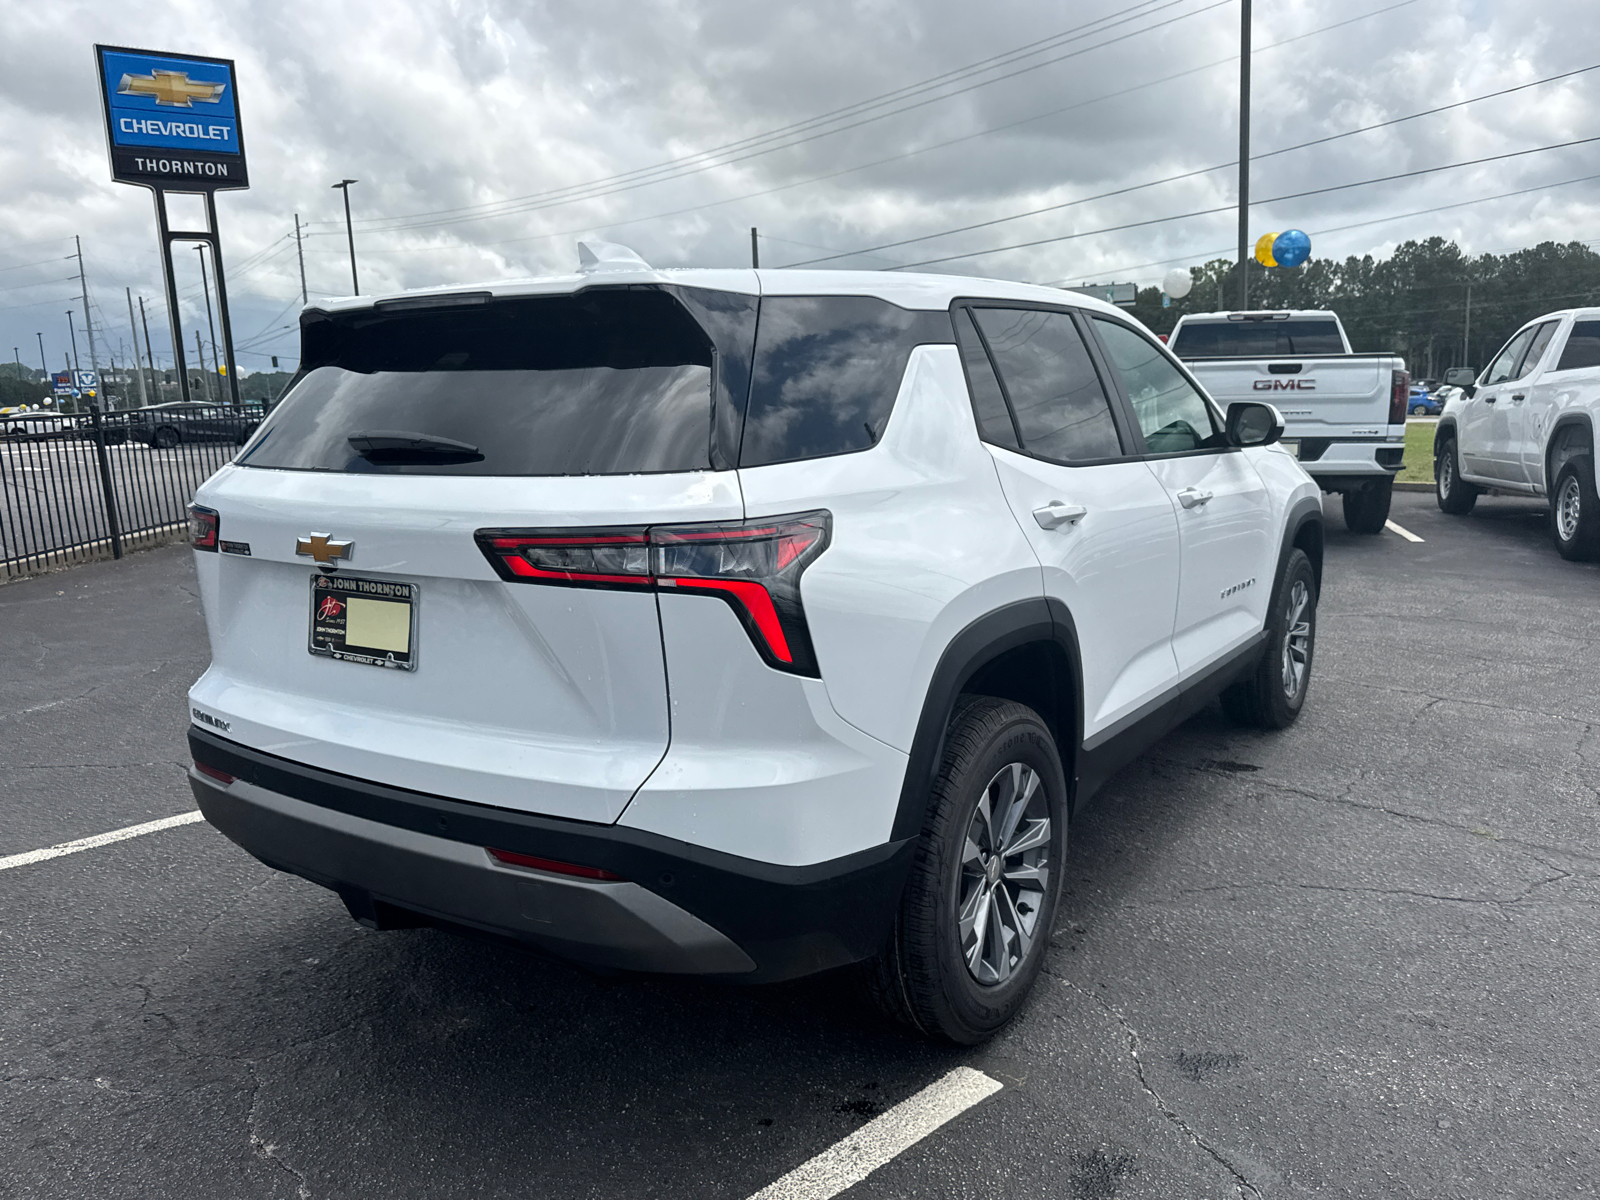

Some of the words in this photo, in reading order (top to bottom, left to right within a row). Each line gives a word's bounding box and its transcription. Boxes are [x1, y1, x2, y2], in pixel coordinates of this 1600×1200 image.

[120, 117, 231, 141] CHEVROLET
[135, 157, 229, 177] THORNTON
[1253, 379, 1316, 391] GMC
[333, 578, 357, 592] JOHN
[358, 581, 410, 597] THORNTON
[343, 654, 374, 665] CHEVROLET
